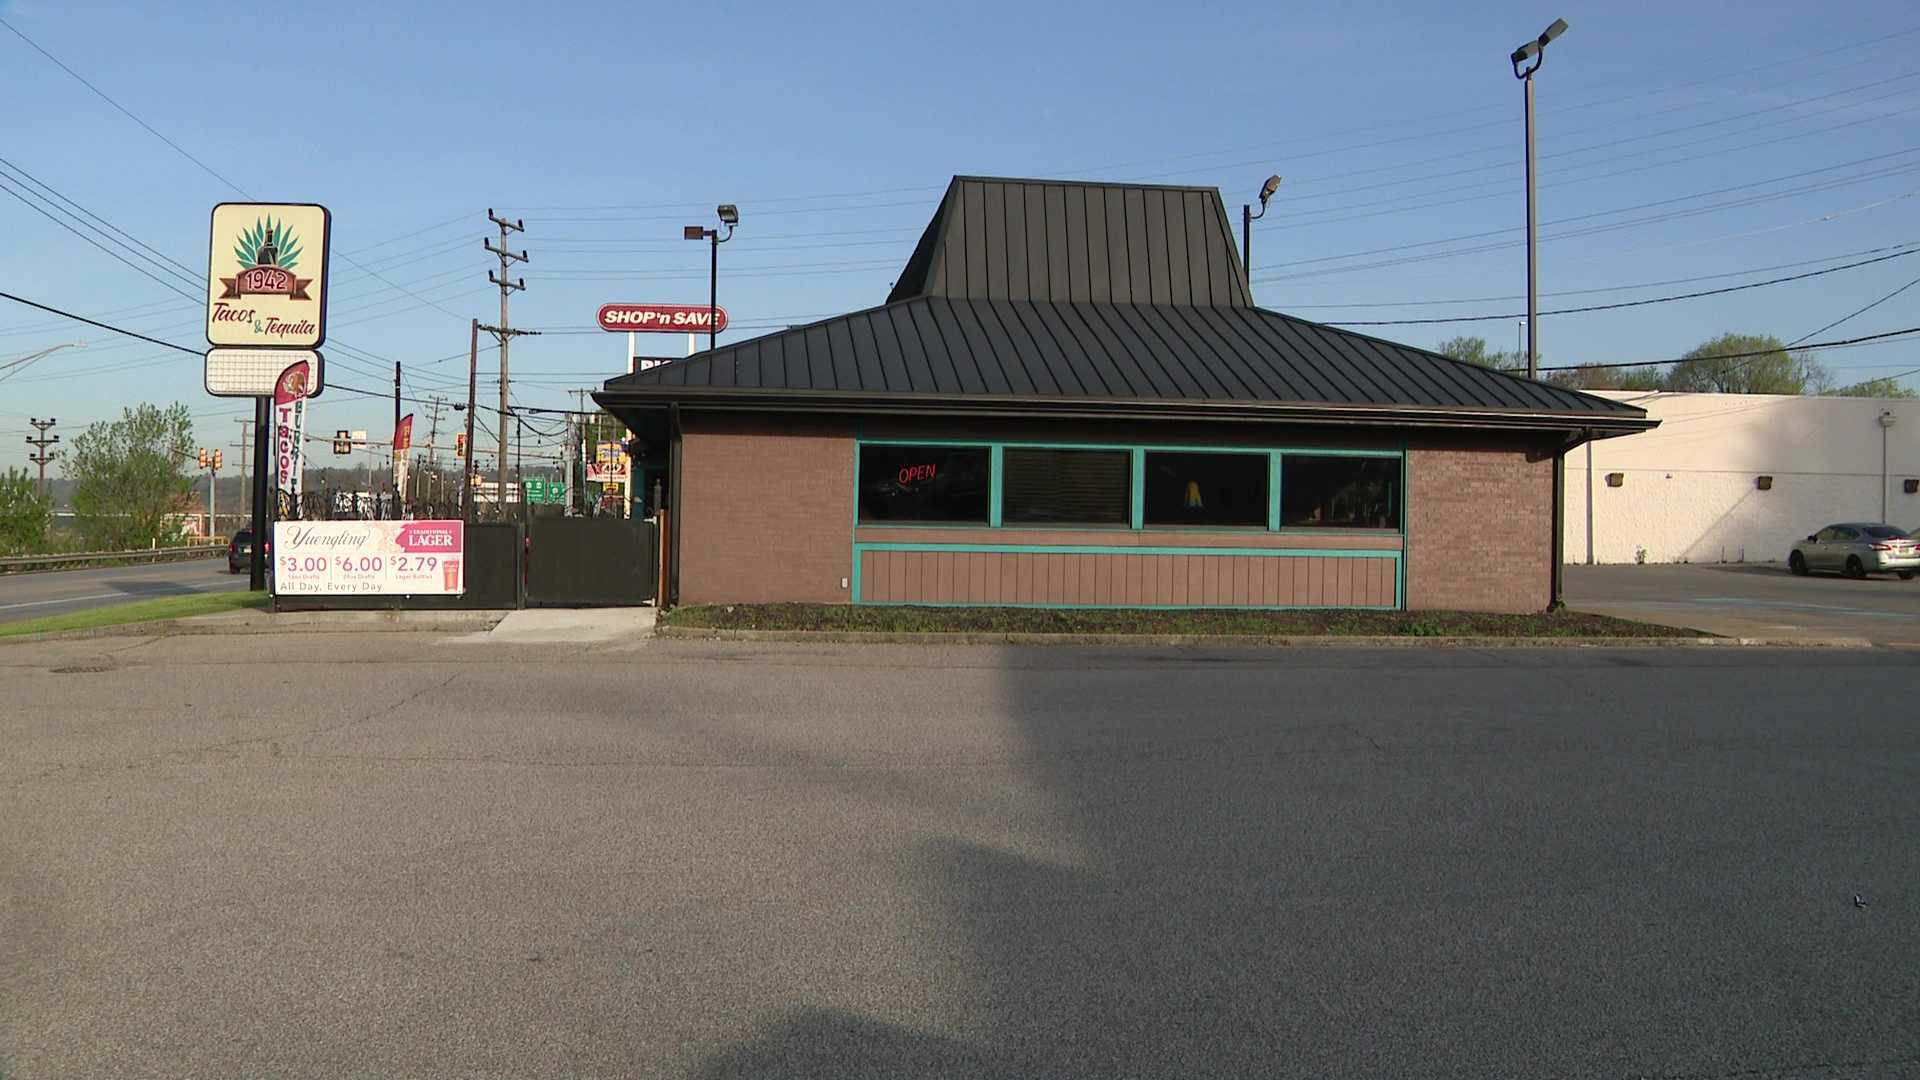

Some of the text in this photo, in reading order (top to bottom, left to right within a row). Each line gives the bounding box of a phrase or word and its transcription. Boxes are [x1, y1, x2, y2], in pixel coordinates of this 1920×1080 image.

[245, 270, 288, 291] 1942
[212, 302, 256, 323] Tacos
[673, 312, 720, 325] SAVE
[254, 317, 316, 339] & Tequila
[899, 464, 936, 484] OPEN
[285, 526, 370, 550] Yuengling
[408, 534, 453, 546] LAGER
[279, 556, 327, 572] $3.00
[335, 556, 383, 572] $6.00
[390, 556, 438, 572] $2.79
[280, 582, 383, 592] All Day, Every Day
